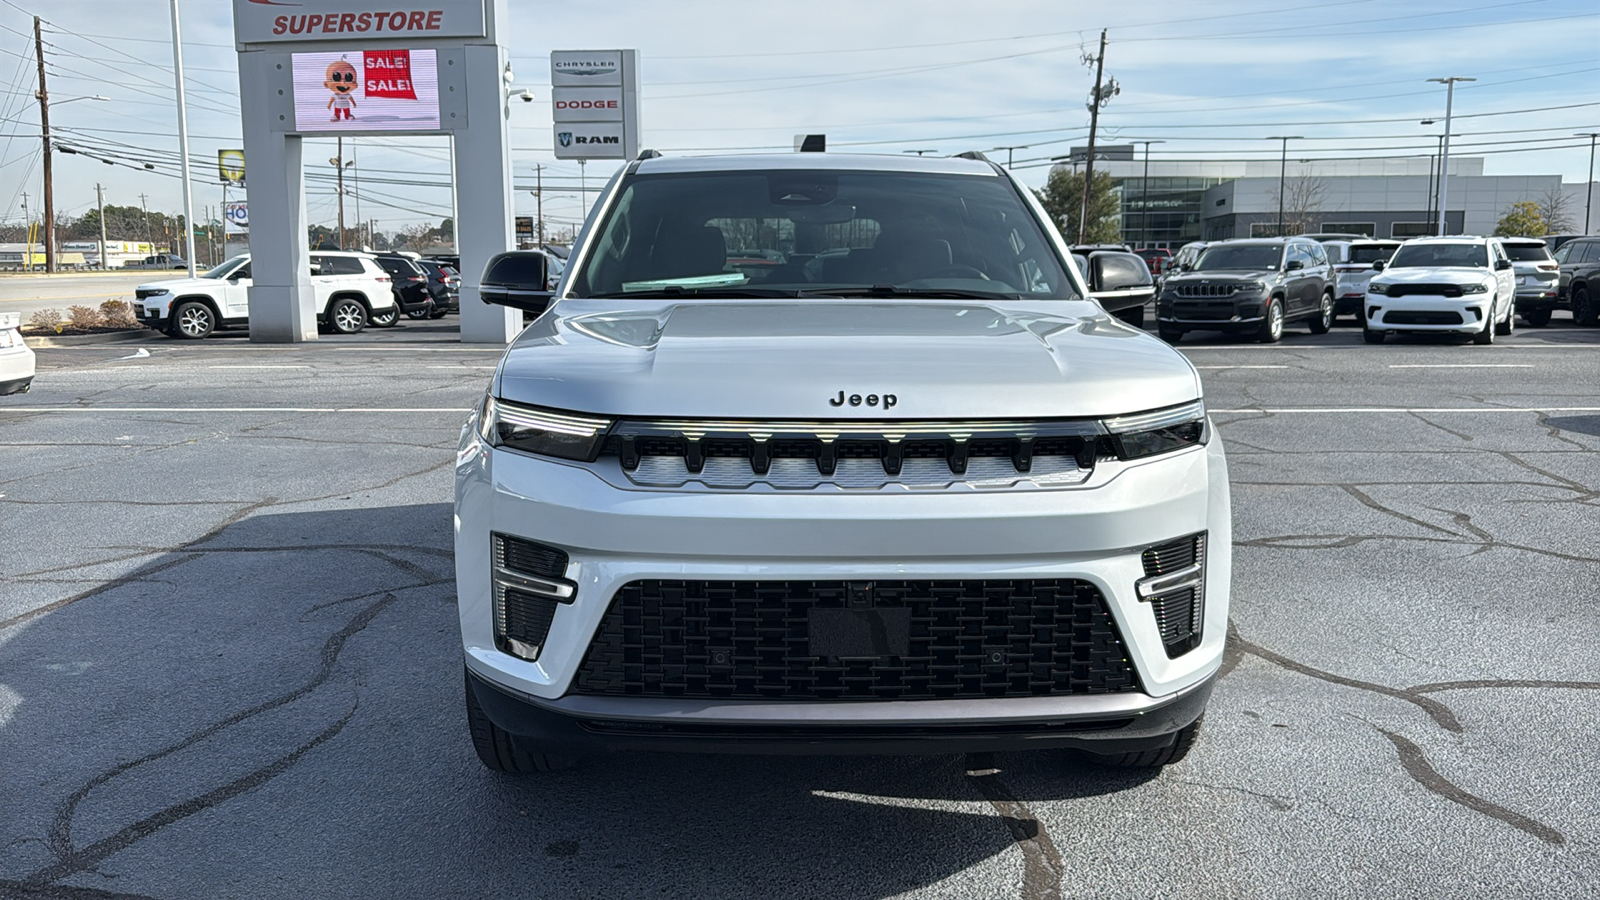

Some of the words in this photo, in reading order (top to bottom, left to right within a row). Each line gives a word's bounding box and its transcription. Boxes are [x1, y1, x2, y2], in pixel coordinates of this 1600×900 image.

[272, 11, 443, 35] SUPERSTORE
[366, 57, 407, 69] SALE!
[367, 79, 411, 91] SALE!
[556, 100, 618, 109] DODGE
[575, 136, 619, 144] RAM
[829, 391, 898, 410] Jeep
